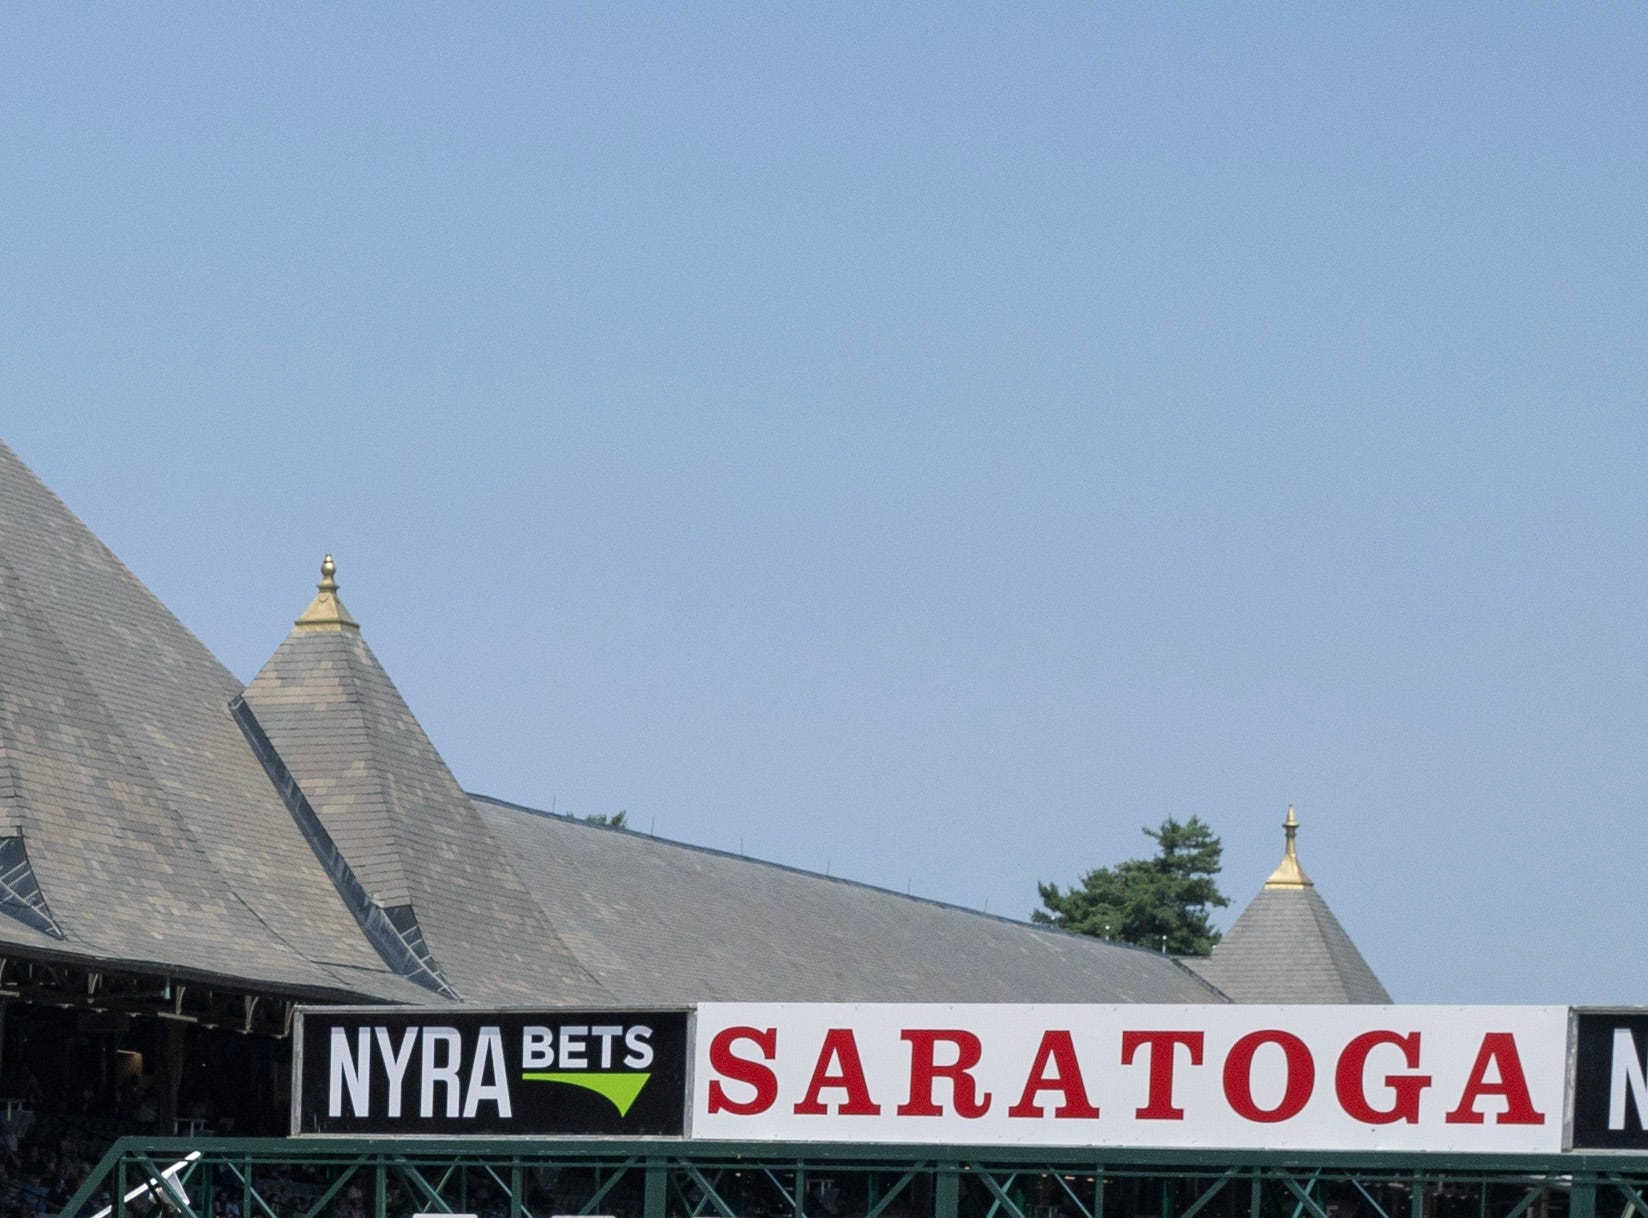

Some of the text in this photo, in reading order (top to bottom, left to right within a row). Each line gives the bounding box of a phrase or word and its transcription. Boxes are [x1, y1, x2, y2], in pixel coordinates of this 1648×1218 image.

[328, 1025, 654, 1118] NYRA BETS
[708, 1026, 1545, 1125] SARATOGA
